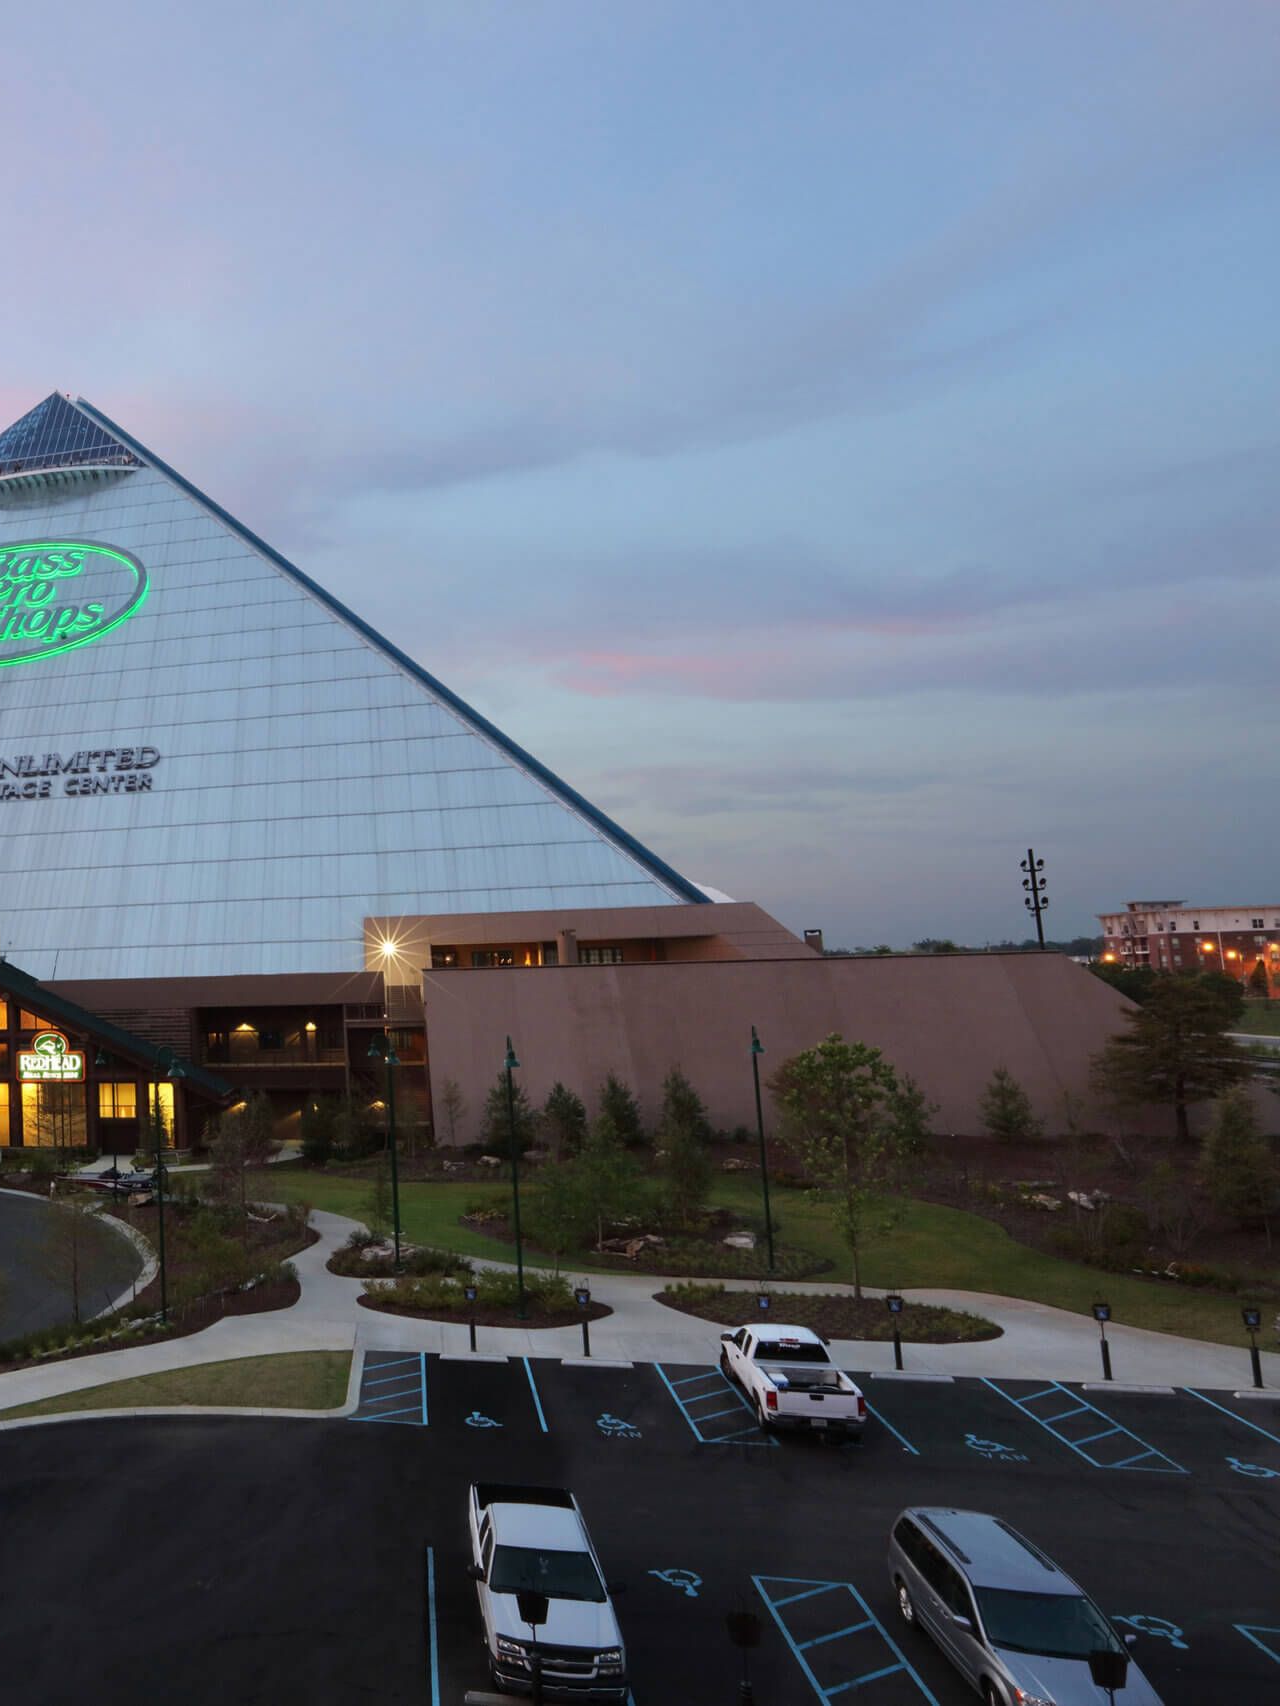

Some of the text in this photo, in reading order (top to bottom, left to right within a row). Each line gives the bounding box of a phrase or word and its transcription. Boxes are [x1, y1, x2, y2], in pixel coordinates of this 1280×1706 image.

[64, 772, 153, 796] CENTER
[600, 1430, 643, 1440] VAN
[978, 1452, 1030, 1463] VAN
